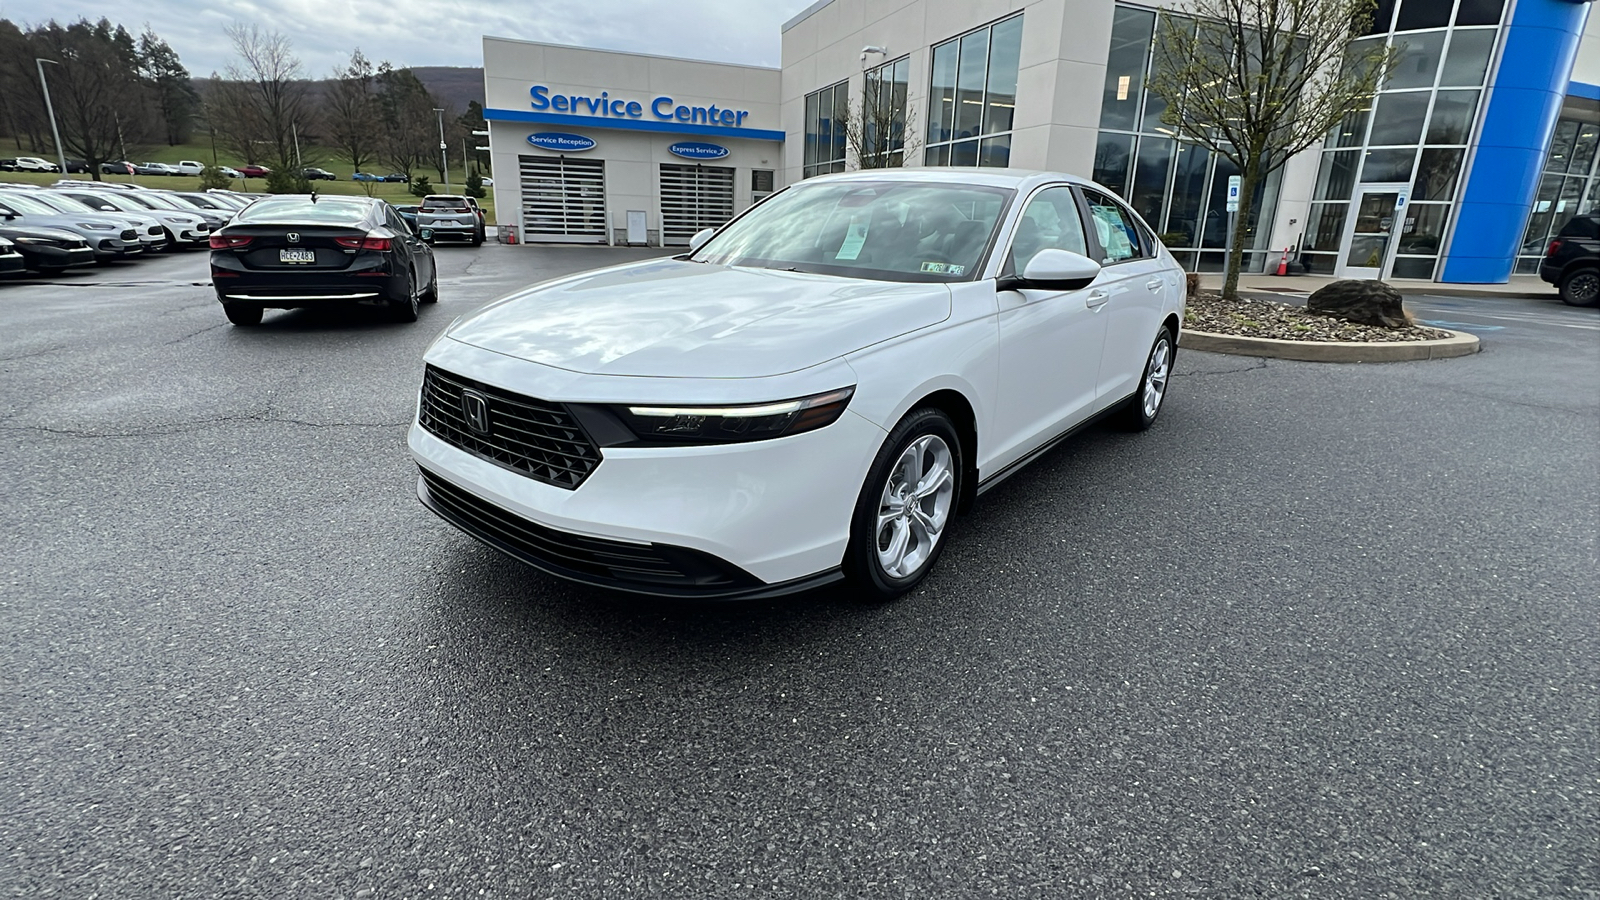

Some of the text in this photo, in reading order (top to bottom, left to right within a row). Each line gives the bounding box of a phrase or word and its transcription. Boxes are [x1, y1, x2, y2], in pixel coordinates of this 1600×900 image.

[530, 85, 749, 126] Service Center
[531, 136, 592, 146] Service Reception
[672, 145, 695, 154] Express
